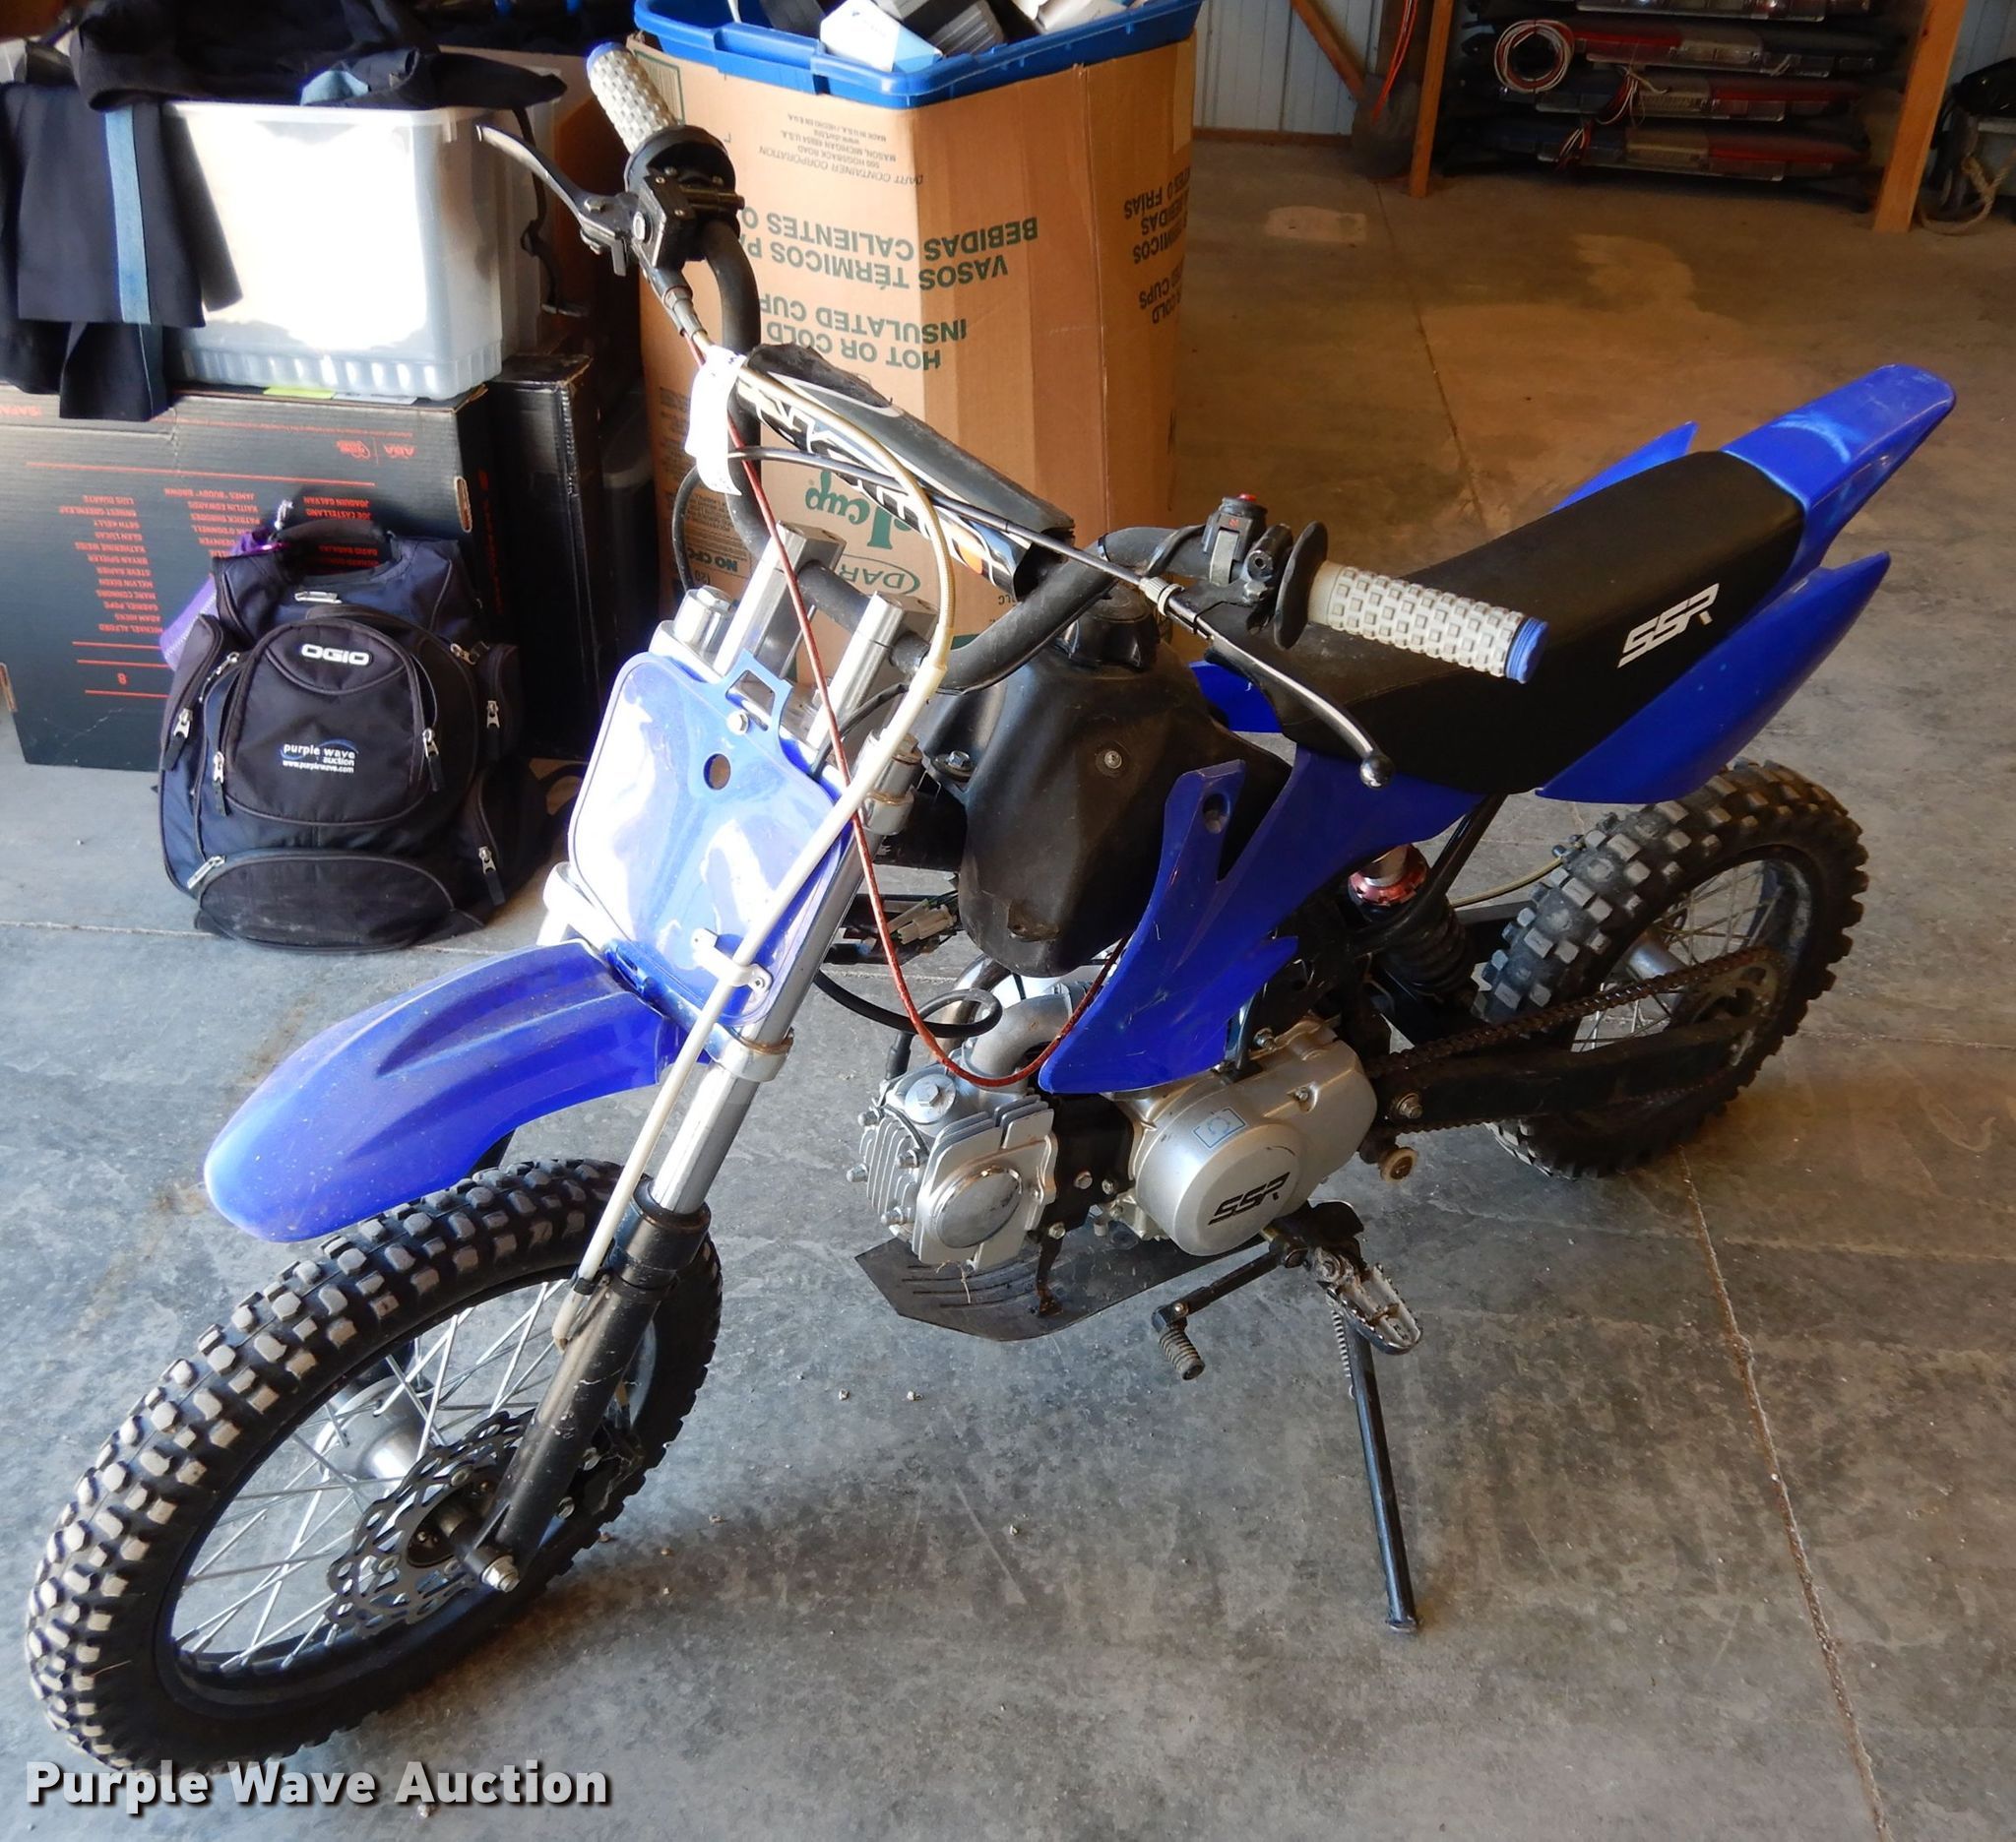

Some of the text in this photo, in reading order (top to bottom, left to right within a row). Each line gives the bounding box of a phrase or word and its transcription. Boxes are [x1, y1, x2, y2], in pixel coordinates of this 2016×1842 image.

[758, 146, 923, 185] DART CONTAINER CORPORATION
[824, 141, 863, 157] MICHIGAN
[1124, 187, 1163, 221] FRÍAS
[741, 206, 1039, 262] BEBIDAS CALIENTES O
[770, 242, 910, 290] TÉRMICOS
[918, 255, 1008, 290] VASOS
[1139, 278, 1169, 309] CUPS
[759, 293, 968, 345] INSULATED CUP
[766, 321, 941, 370] HOT OR COLD
[715, 556, 738, 573] NO
[839, 563, 906, 589] DAR
[1617, 583, 1720, 669] SSR
[301, 644, 370, 666] OGIO
[284, 743, 356, 758] purple wave
[323, 755, 354, 766] auction
[1208, 1172, 1291, 1226] SSR
